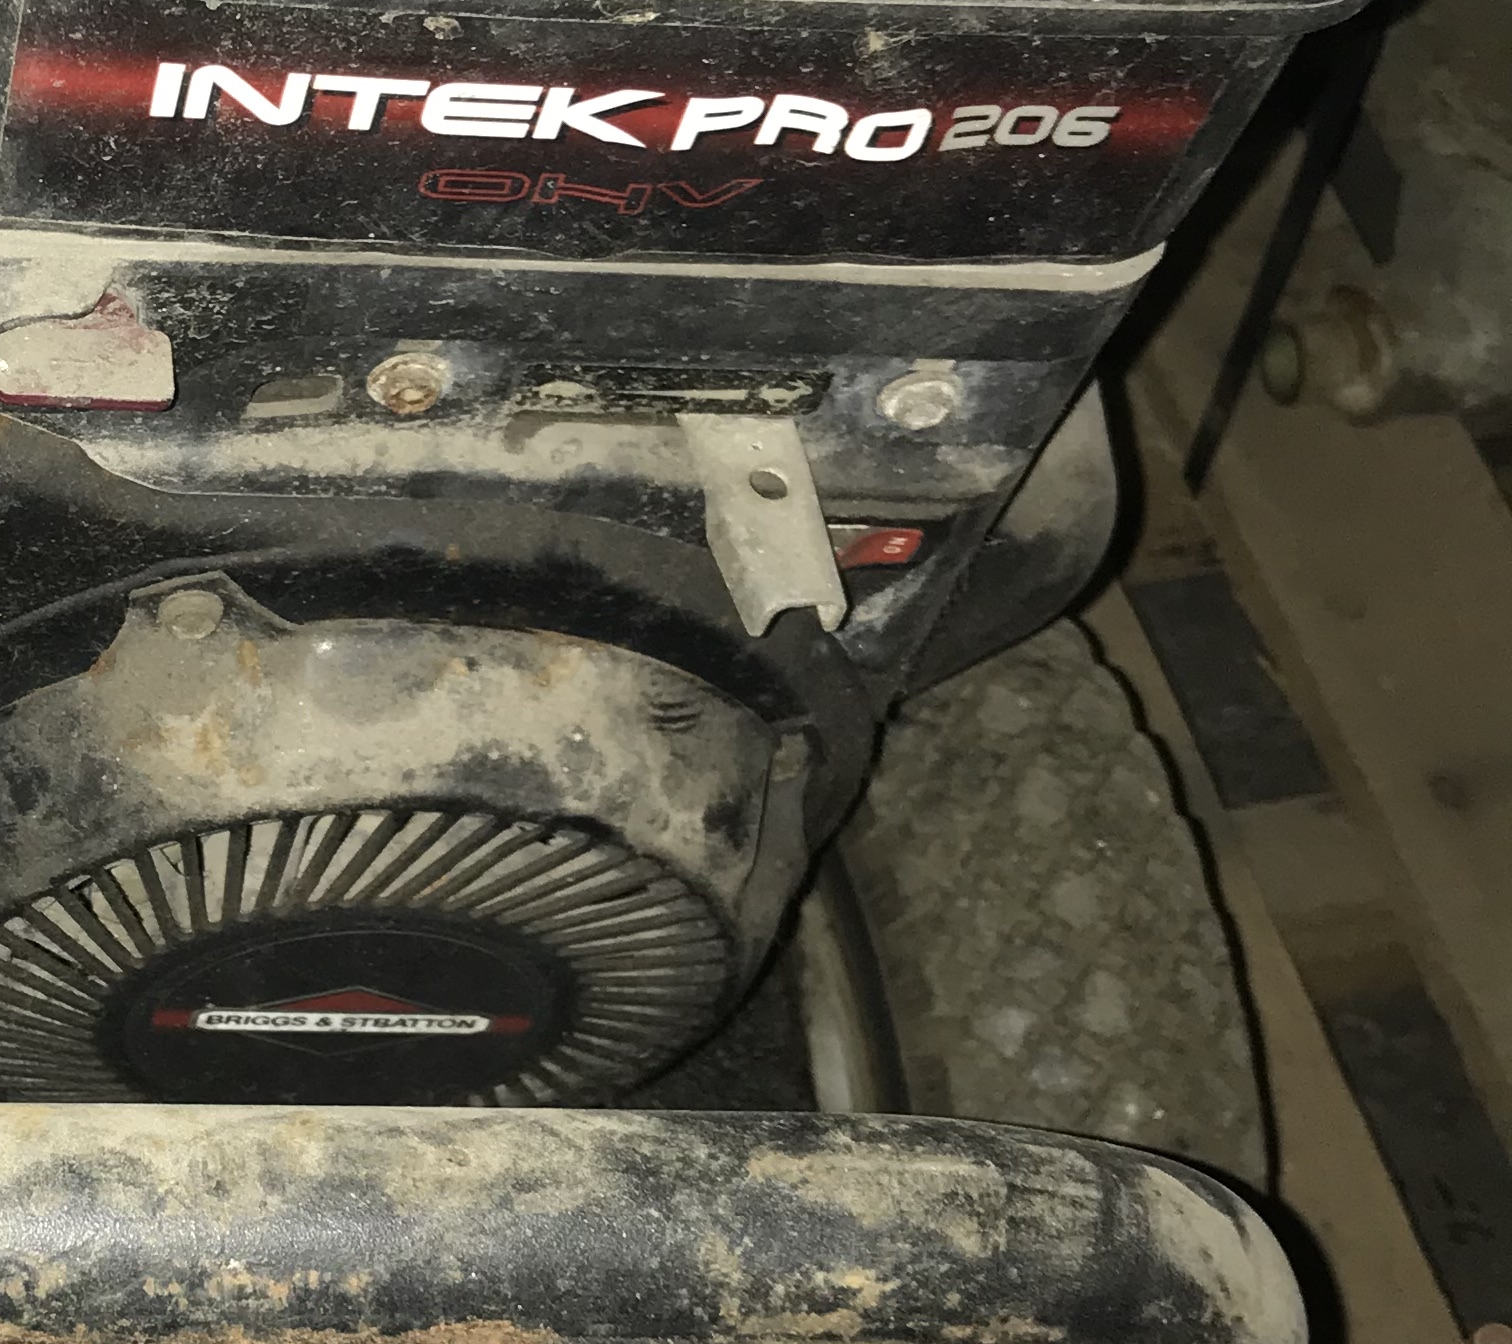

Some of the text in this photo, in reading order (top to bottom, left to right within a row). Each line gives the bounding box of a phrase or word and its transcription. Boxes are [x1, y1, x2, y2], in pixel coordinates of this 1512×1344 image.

[150, 62, 1122, 162] INTEK PRO 206
[418, 168, 765, 216] OHV
[205, 1013, 478, 1031] BRIGGS & STRATTON
